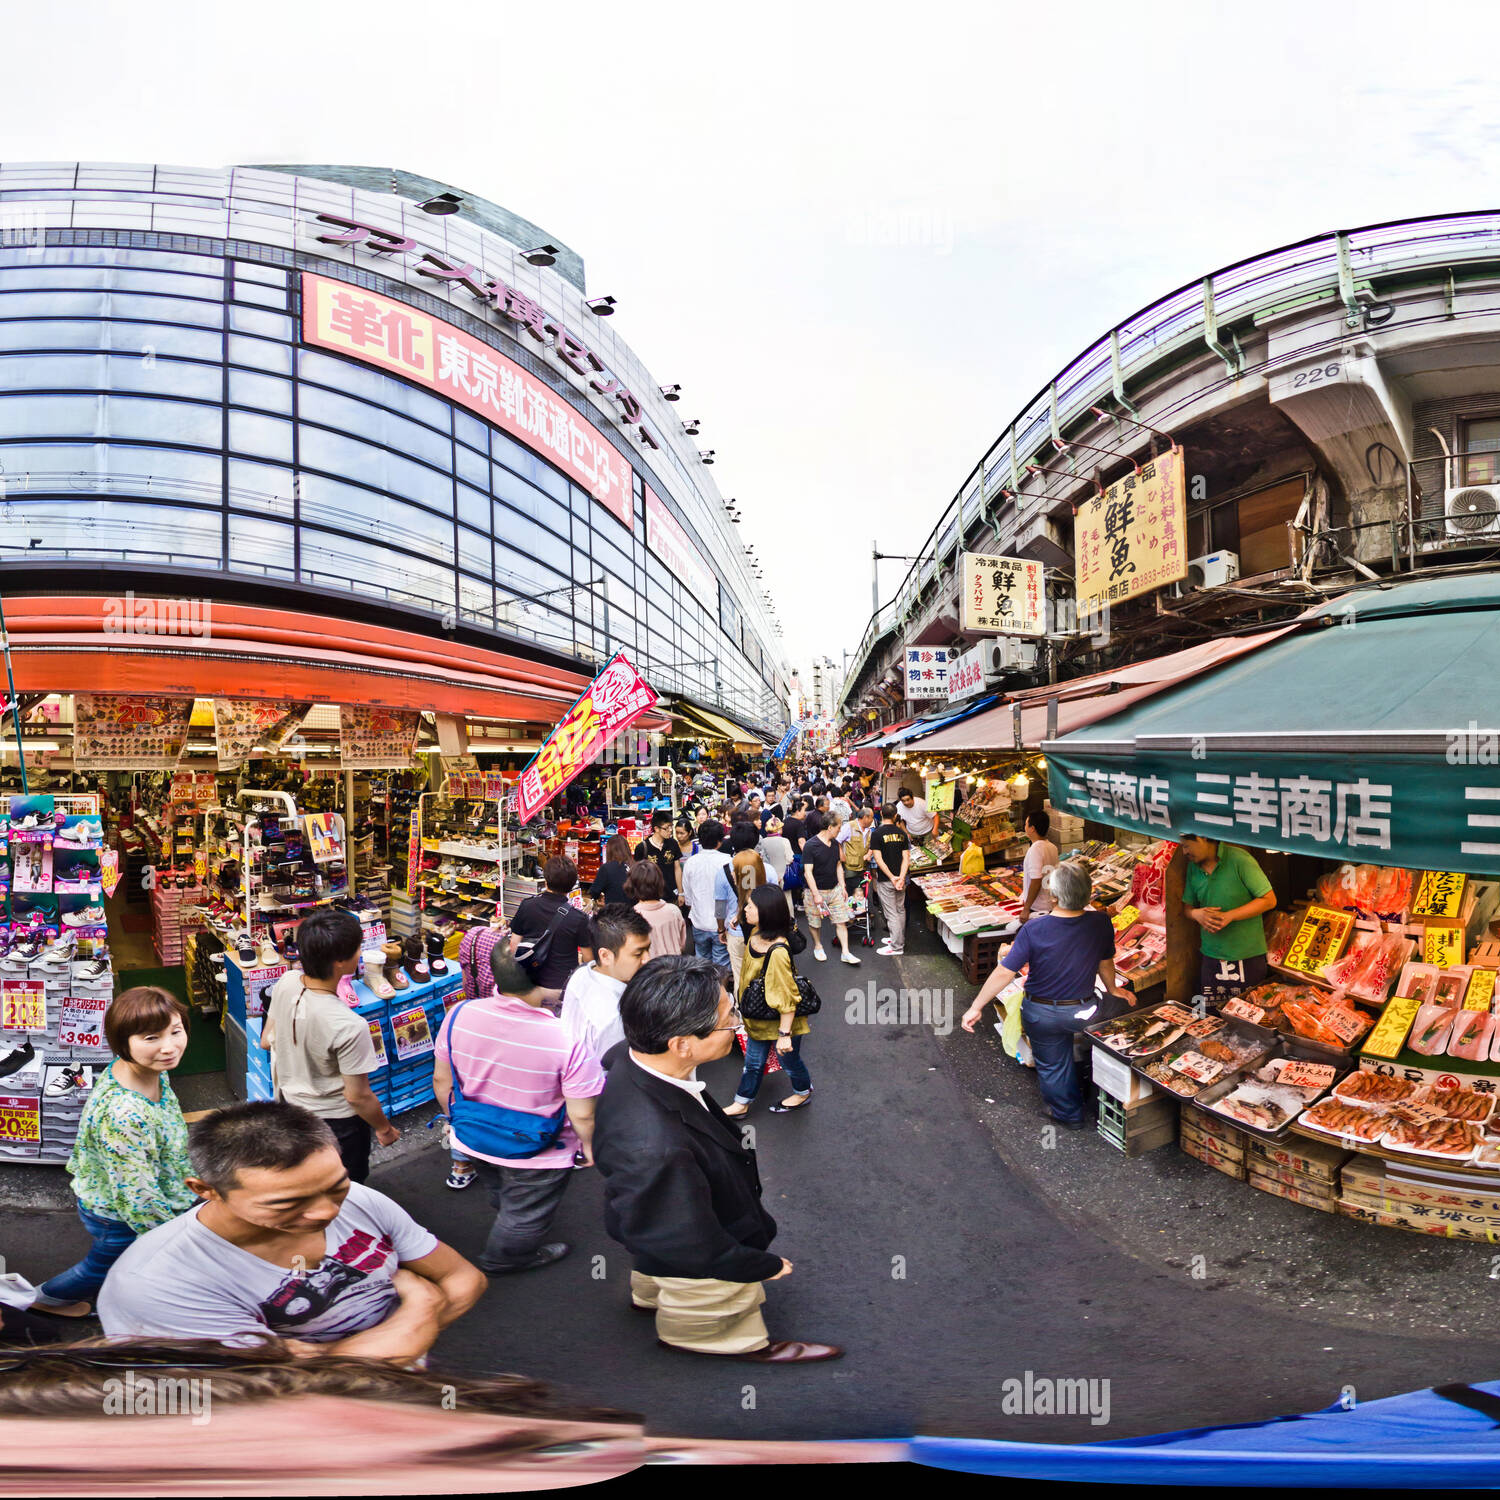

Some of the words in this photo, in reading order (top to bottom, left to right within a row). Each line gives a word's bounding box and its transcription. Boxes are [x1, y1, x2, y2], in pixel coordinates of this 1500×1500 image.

[316, 213, 659, 449] アメ横センター
[330, 291, 425, 371] 靴
[437, 334, 620, 495] 東京靴流通センター
[1294, 363, 1340, 388] 226
[1090, 463, 1157, 514] 冷凍食品
[1104, 493, 1137, 582] 鮮魚
[1147, 488, 1160, 550] ひらめ
[975, 557, 1023, 572] 冷凍食品
[974, 574, 984, 611] タラバガニ
[991, 571, 1017, 617] 鮮魚
[1065, 768, 1173, 830] 三幸商店
[1194, 771, 1393, 851] 三幸商店
[1437, 933, 1448, 967] まぐろ
[1375, 1004, 1402, 1038] 大トロ
